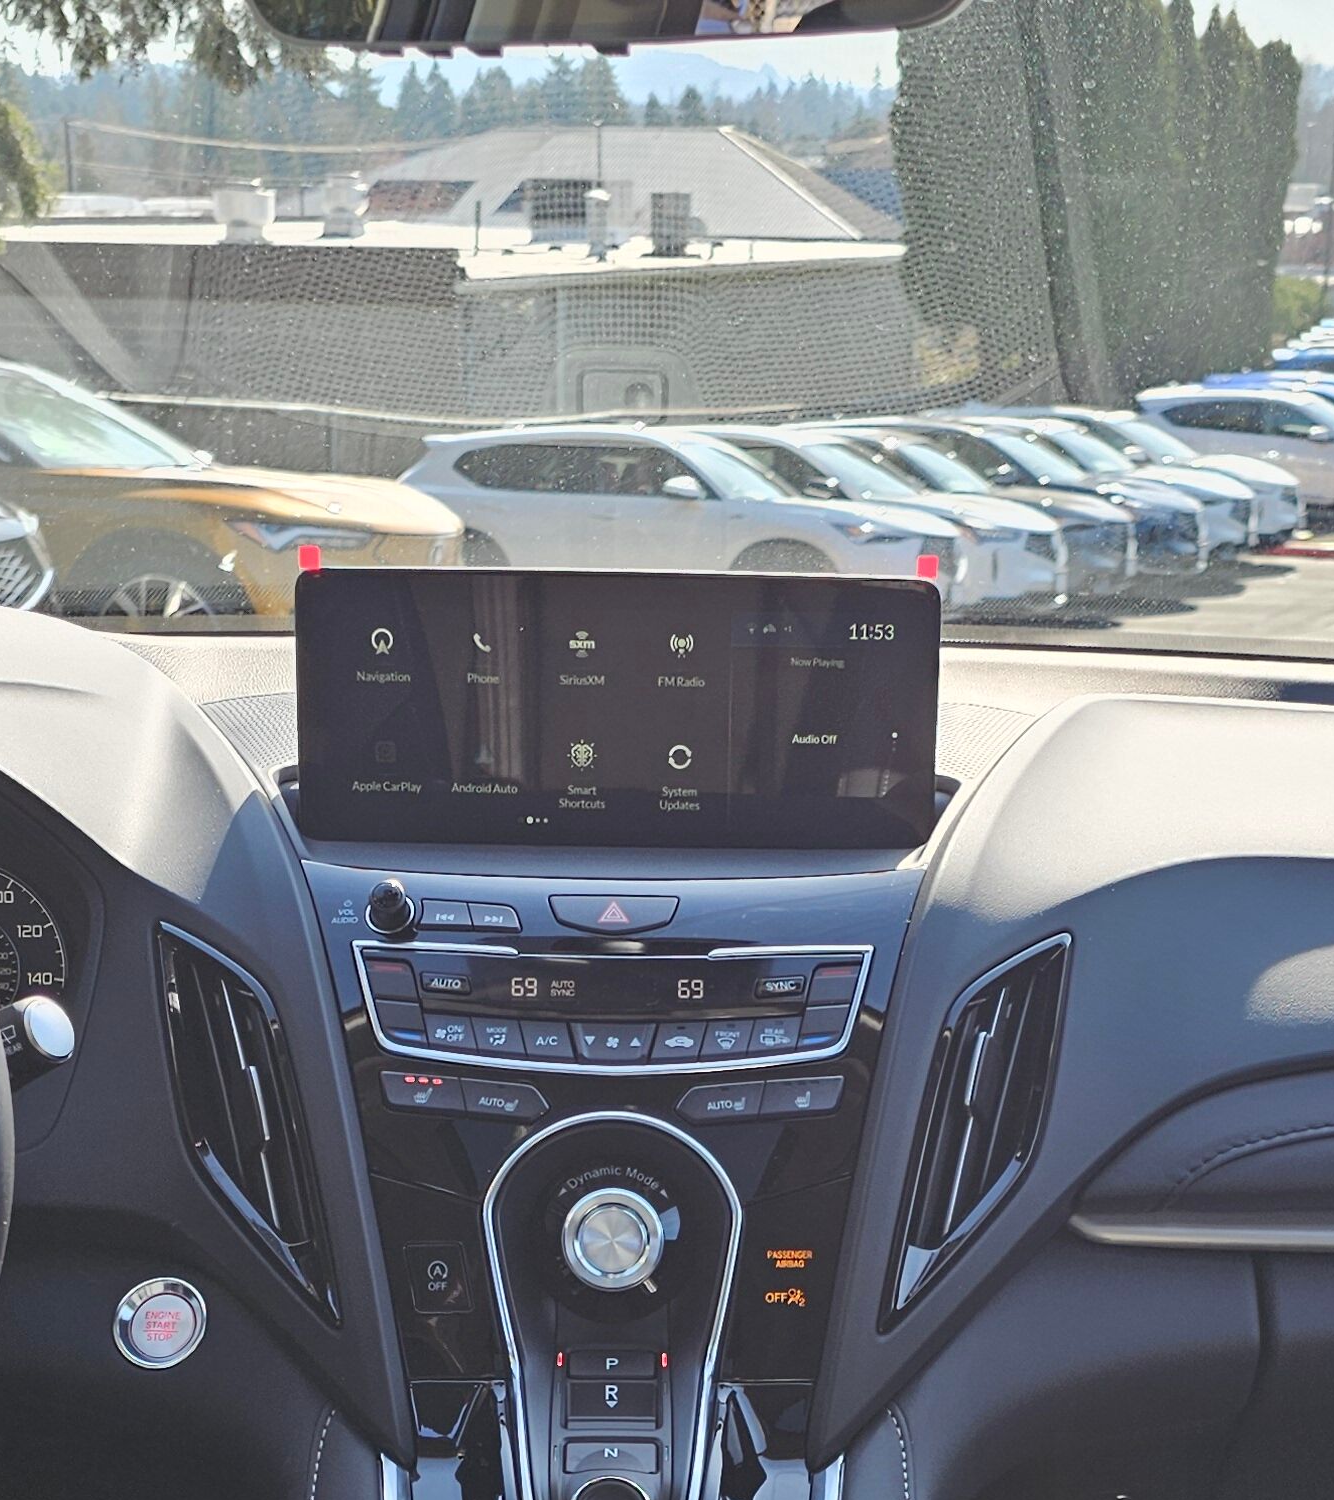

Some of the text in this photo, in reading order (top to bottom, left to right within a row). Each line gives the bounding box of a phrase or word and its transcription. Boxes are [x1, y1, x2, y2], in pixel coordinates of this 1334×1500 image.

[848, 623, 895, 641] 11:53
[569, 638, 596, 650] sxm
[790, 656, 846, 670] Now Playing
[356, 671, 411, 685] Navigation
[467, 673, 501, 685] Phone
[559, 674, 606, 686] SiriusXM
[657, 676, 706, 688] FM Radio
[791, 733, 838, 745] Audio Off
[351, 780, 422, 794] Apple CarPlay
[451, 782, 518, 795] Android Auto
[567, 784, 597, 797] Smart
[661, 785, 698, 799] System
[558, 797, 606, 810] Shortcuts
[658, 799, 700, 812] Updates
[338, 908, 356, 917] VOL
[331, 915, 359, 925] AUDIO
[17, 924, 43, 938] 120
[26, 971, 53, 985] 140
[430, 978, 462, 989] AUTO
[550, 979, 575, 989] AUTO
[510, 976, 538, 998] 69
[677, 978, 704, 999] 69
[765, 980, 797, 991] SYNC
[550, 988, 576, 997] SYNC
[486, 1026, 508, 1034] MODE
[714, 1030, 741, 1039] FRONT
[446, 1033, 465, 1043] OFF
[535, 1036, 559, 1047] A/C
[478, 1096, 505, 1109] AUTO
[707, 1099, 734, 1111] AUTO
[567, 1164, 660, 1191] Dynamic Mode
[766, 1249, 813, 1260] PASSENGER
[775, 1259, 805, 1269] AIRBAG
[427, 1281, 448, 1291] OFF
[765, 1291, 788, 1304] OFF
[145, 1311, 181, 1320] ENGINE
[146, 1321, 177, 1329] START
[147, 1333, 173, 1341] STOP
[605, 1357, 619, 1371] P
[604, 1385, 619, 1400] R
[604, 1447, 619, 1459] N
